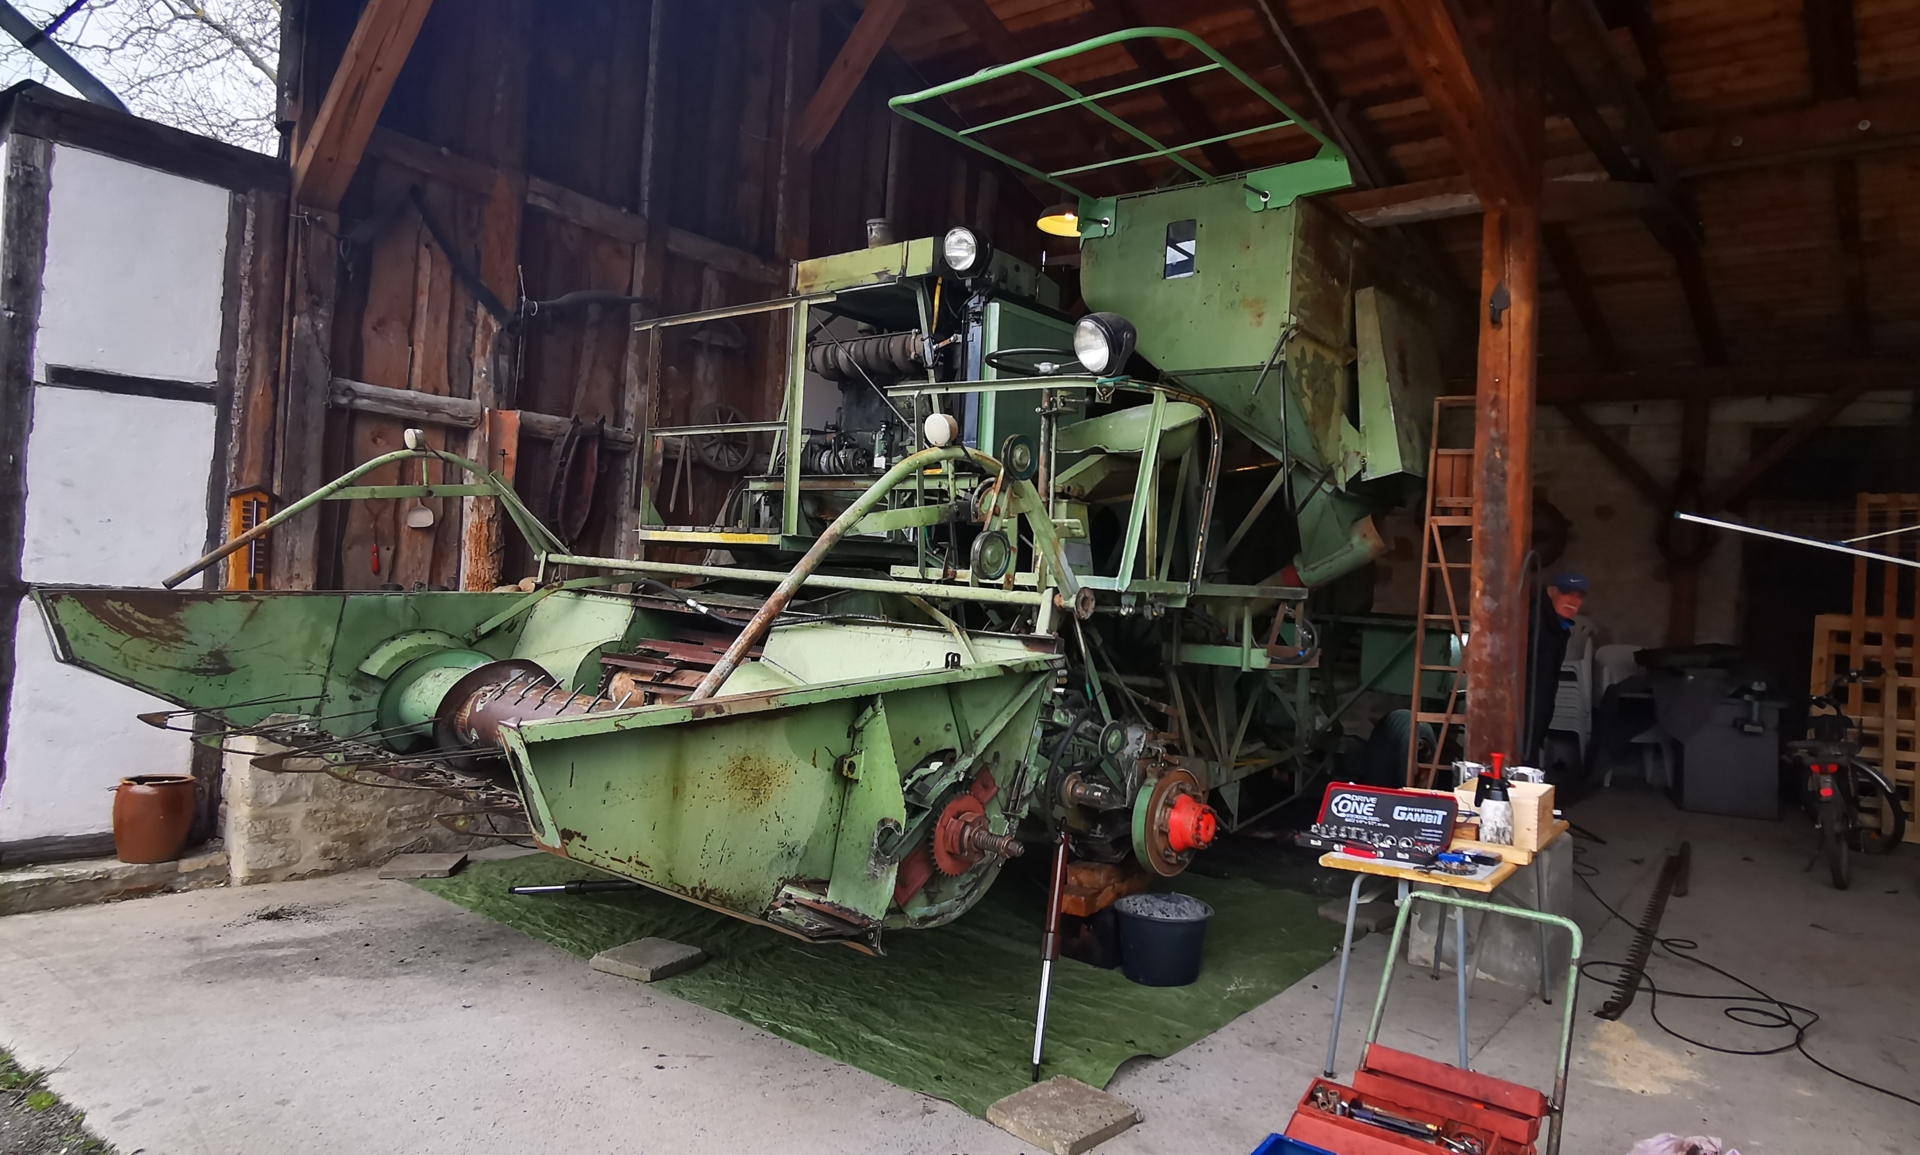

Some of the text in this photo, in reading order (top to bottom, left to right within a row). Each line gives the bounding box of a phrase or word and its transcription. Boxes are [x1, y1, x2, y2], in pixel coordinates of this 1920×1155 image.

[1338, 799, 1376, 816] ONE
[1350, 794, 1378, 804] DRIVE
[1392, 805, 1448, 825] GAMBIT
